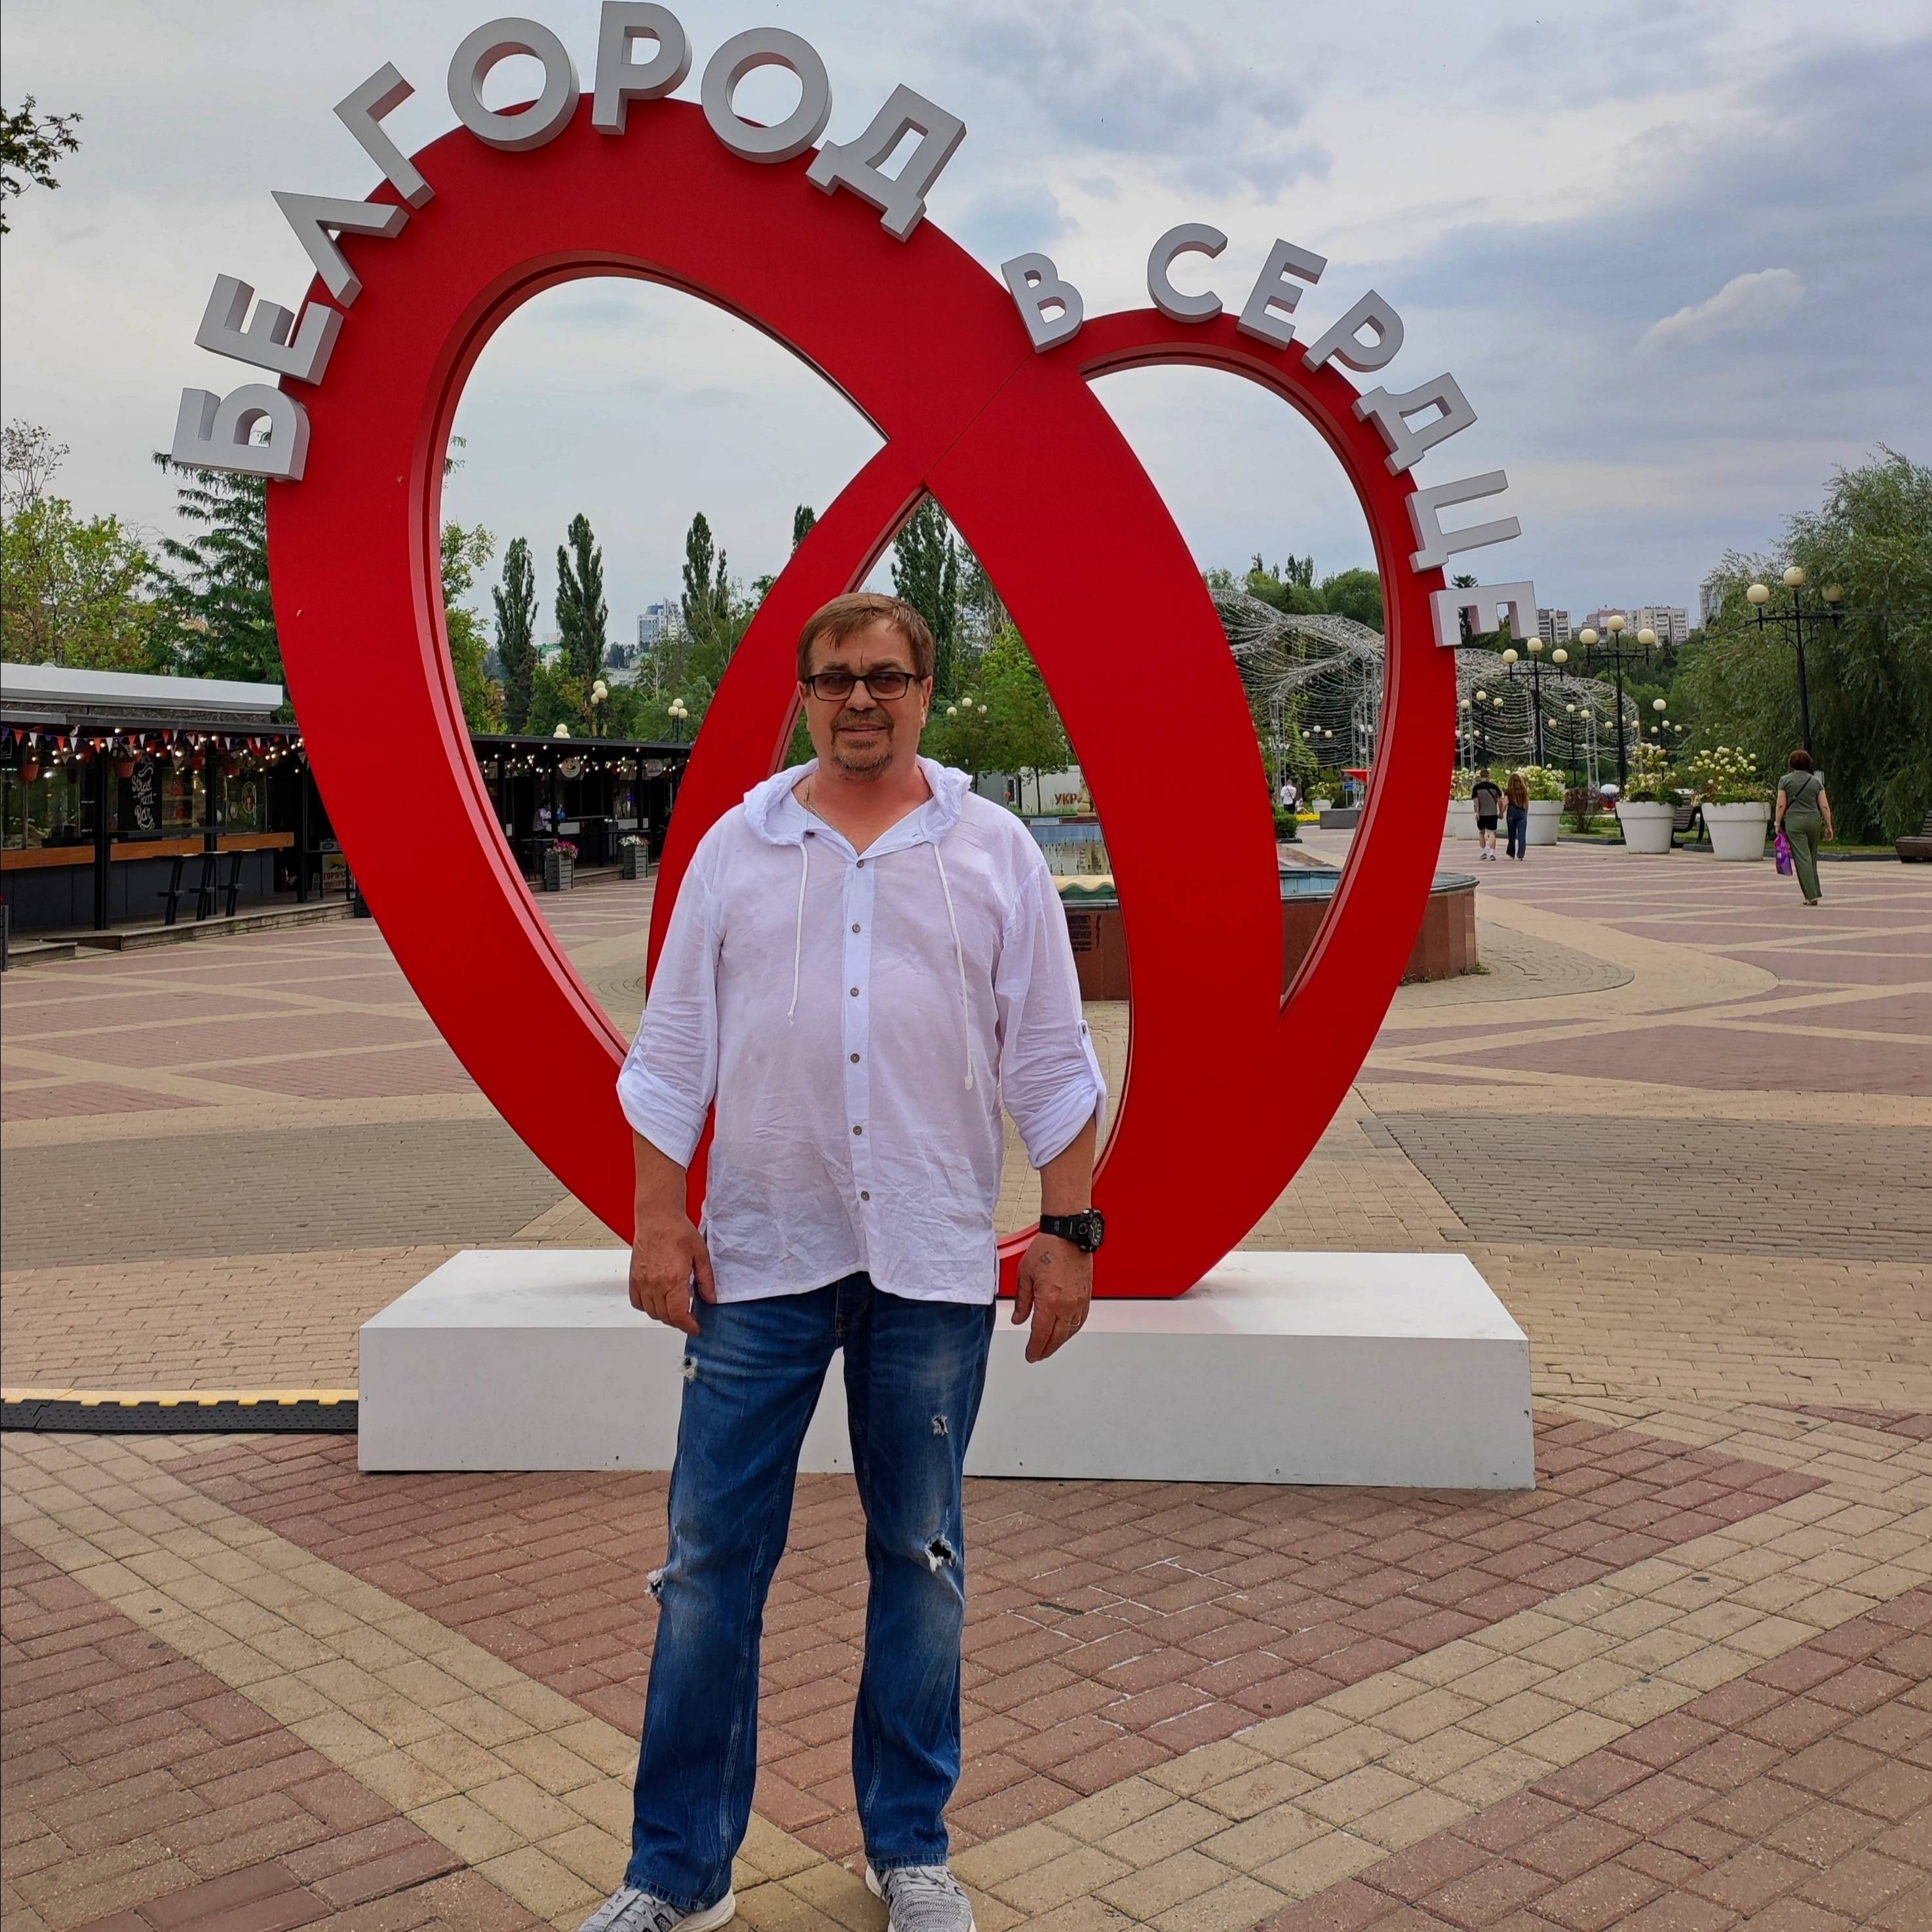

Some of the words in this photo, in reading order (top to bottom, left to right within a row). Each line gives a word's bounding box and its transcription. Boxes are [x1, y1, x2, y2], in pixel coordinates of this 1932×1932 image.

[172, 1, 967, 481] БЕЛГОРОД
[1001, 252, 1083, 354] В
[1147, 223, 1539, 647] СЕРДЦЕ
[134, 805, 153, 826] Bar
